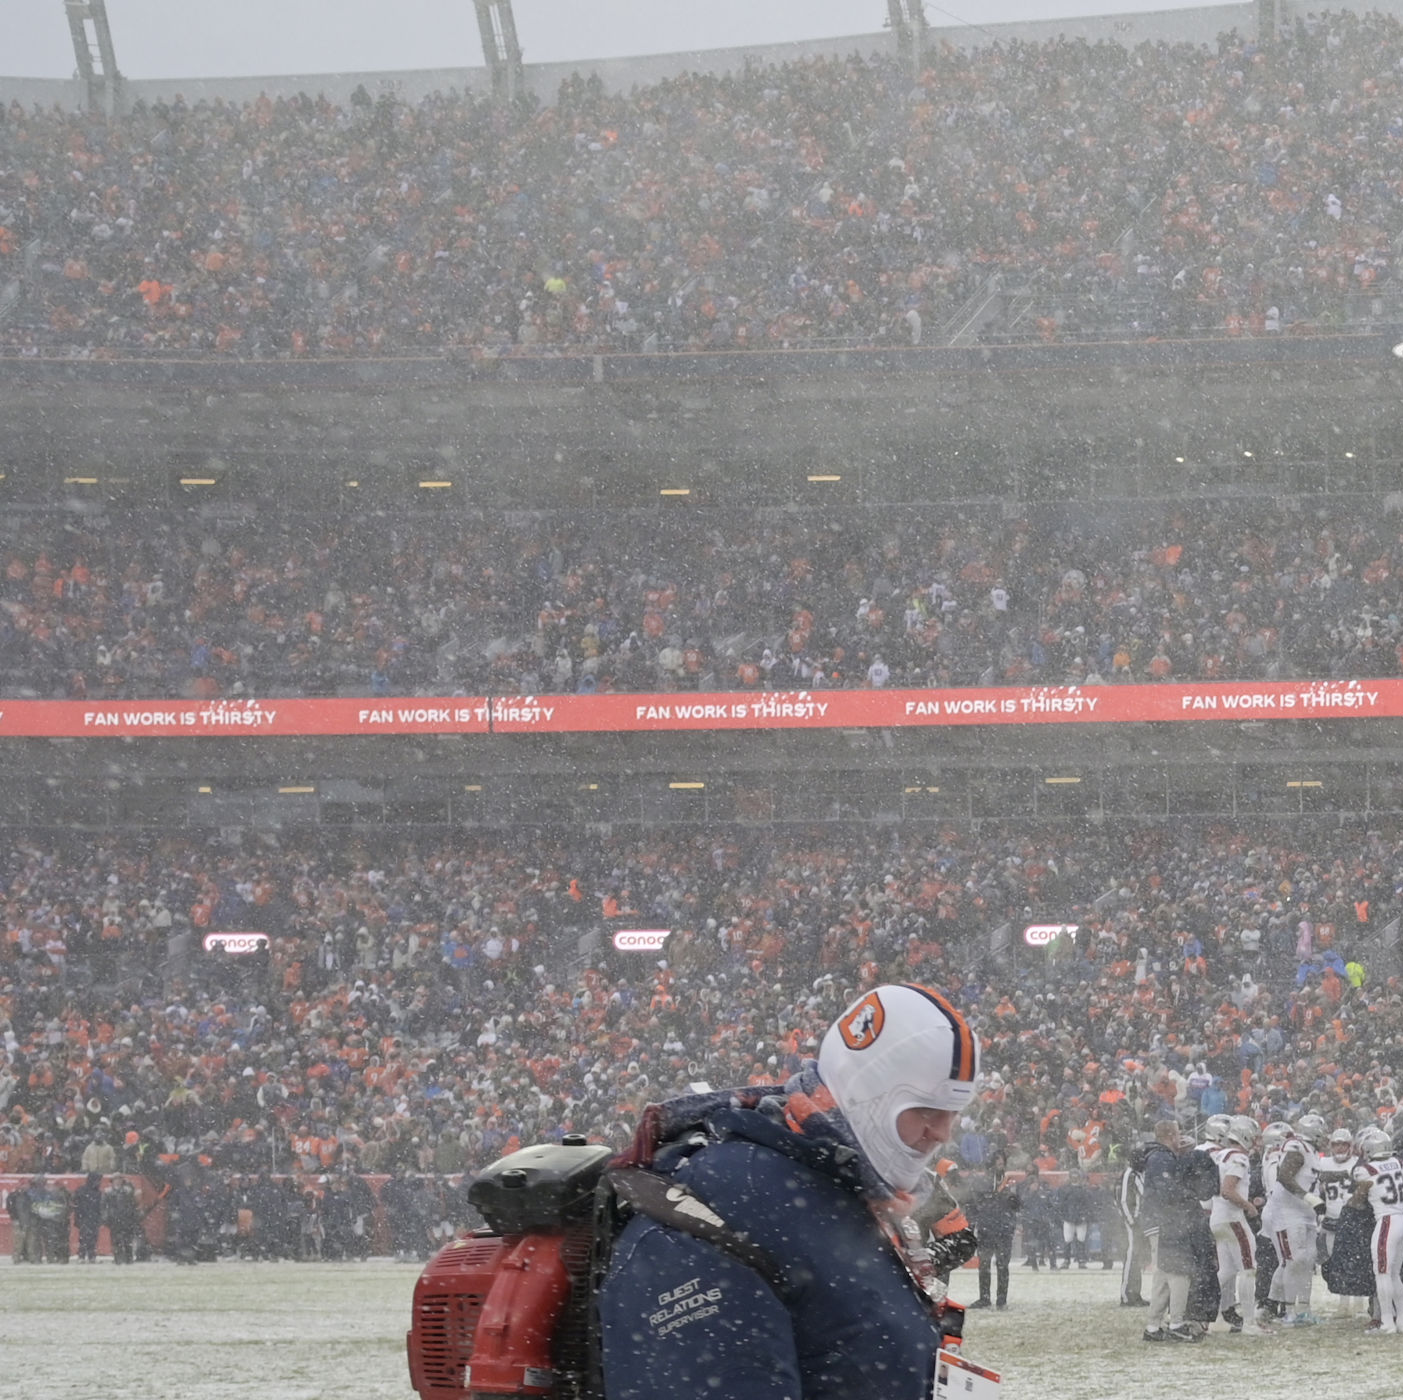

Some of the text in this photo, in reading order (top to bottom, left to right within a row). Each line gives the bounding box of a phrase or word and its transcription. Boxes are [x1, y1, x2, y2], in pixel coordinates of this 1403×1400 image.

[905, 697, 1098, 714] FAN WORK IS THIRSTY
[1182, 691, 1379, 709] FAN WORK IS THIRSTY
[84, 709, 276, 725] FAN WORK IS THIRSTY
[359, 706, 554, 722] FAN WORK IS THIRSTY
[636, 702, 828, 719] FAN WORK IS THIRSTY
[658, 1277, 701, 1306] GUEST
[648, 1288, 722, 1327] RELATIONS
[657, 1314, 721, 1337] SUPERVISOR
